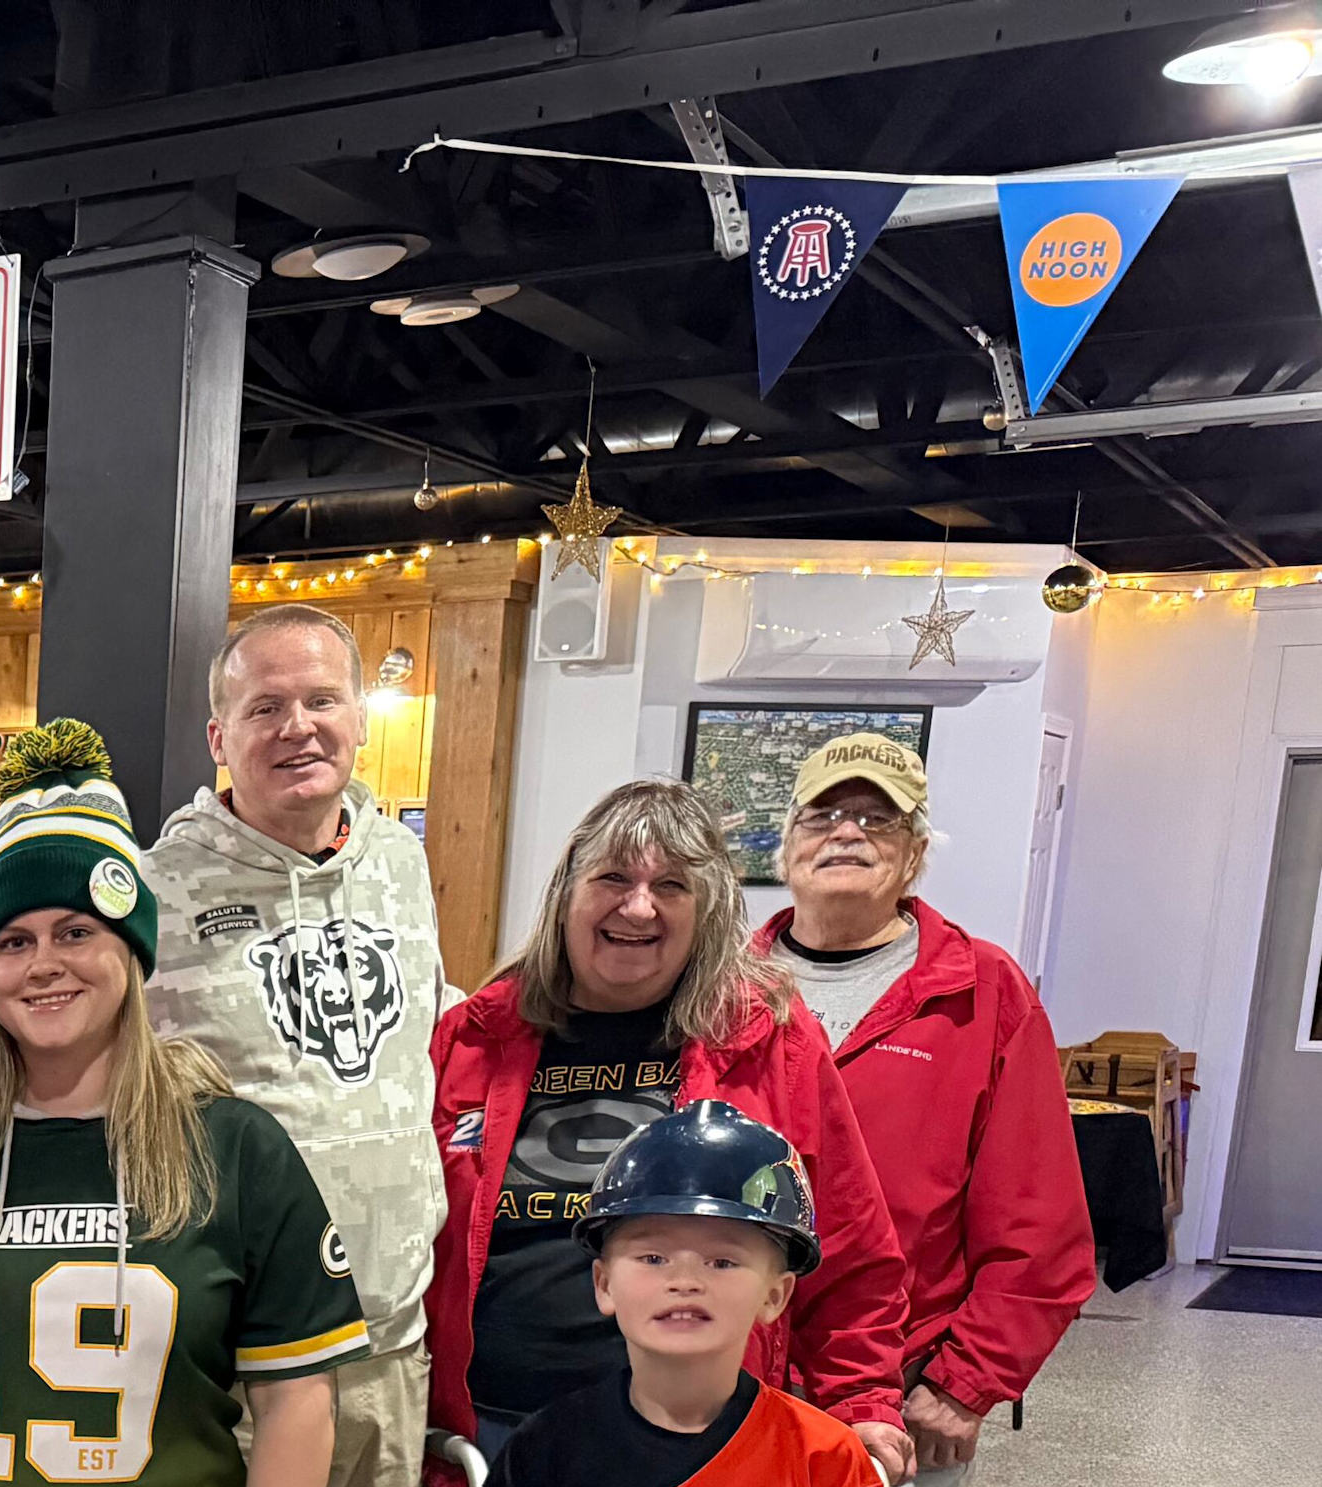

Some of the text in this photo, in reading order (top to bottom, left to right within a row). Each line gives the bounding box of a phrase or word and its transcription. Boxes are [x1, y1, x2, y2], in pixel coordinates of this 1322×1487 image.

[1039, 241, 1107, 258] HIGH
[1028, 261, 1108, 279] NOON
[824, 744, 907, 772] PACKERS
[205, 905, 244, 919] SALUTE
[203, 920, 255, 935] TO SERVICE
[529, 1064, 625, 1094] REEN
[77, 1448, 117, 1471] EST
